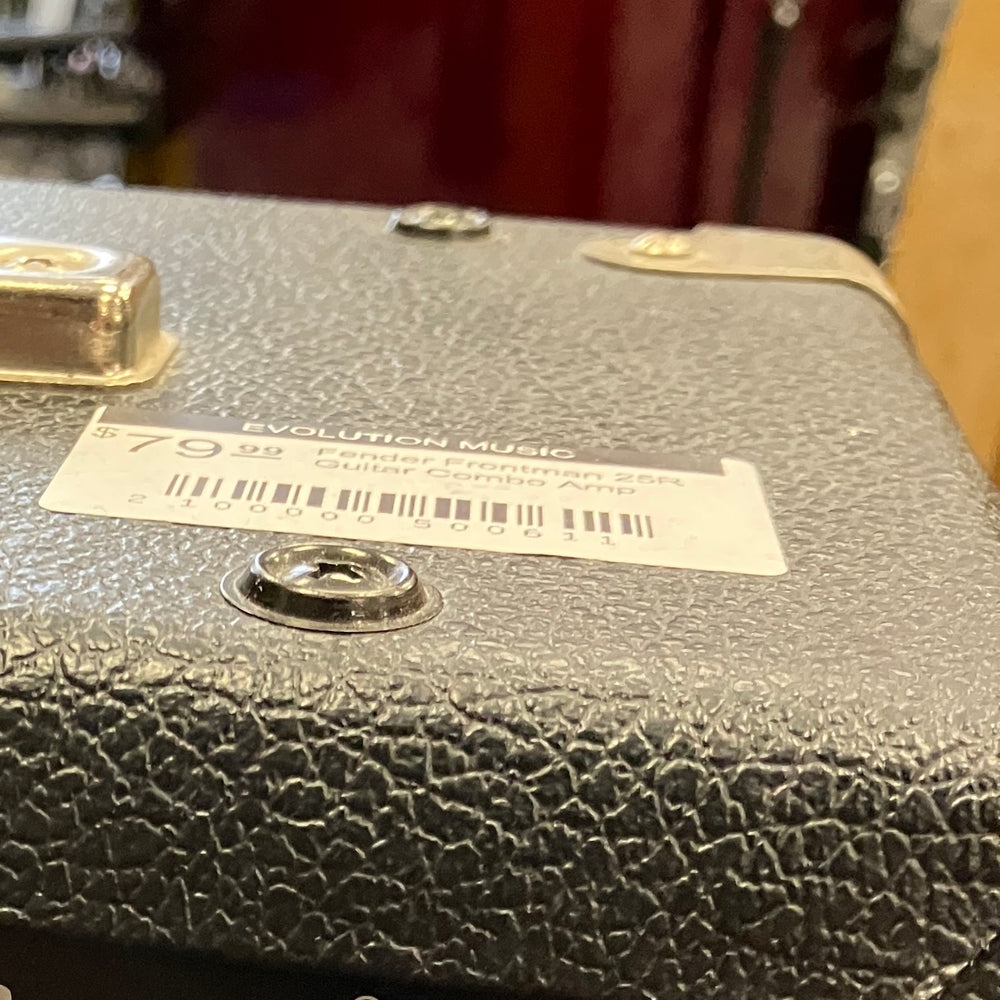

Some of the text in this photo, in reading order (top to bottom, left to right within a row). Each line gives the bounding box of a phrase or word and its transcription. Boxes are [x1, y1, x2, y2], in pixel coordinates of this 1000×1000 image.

[242, 422, 576, 460] EVOLUTION MUSIC
[314, 458, 637, 496] Guitar Combo Amp
[316, 447, 685, 487] Fender Frontman 25R
